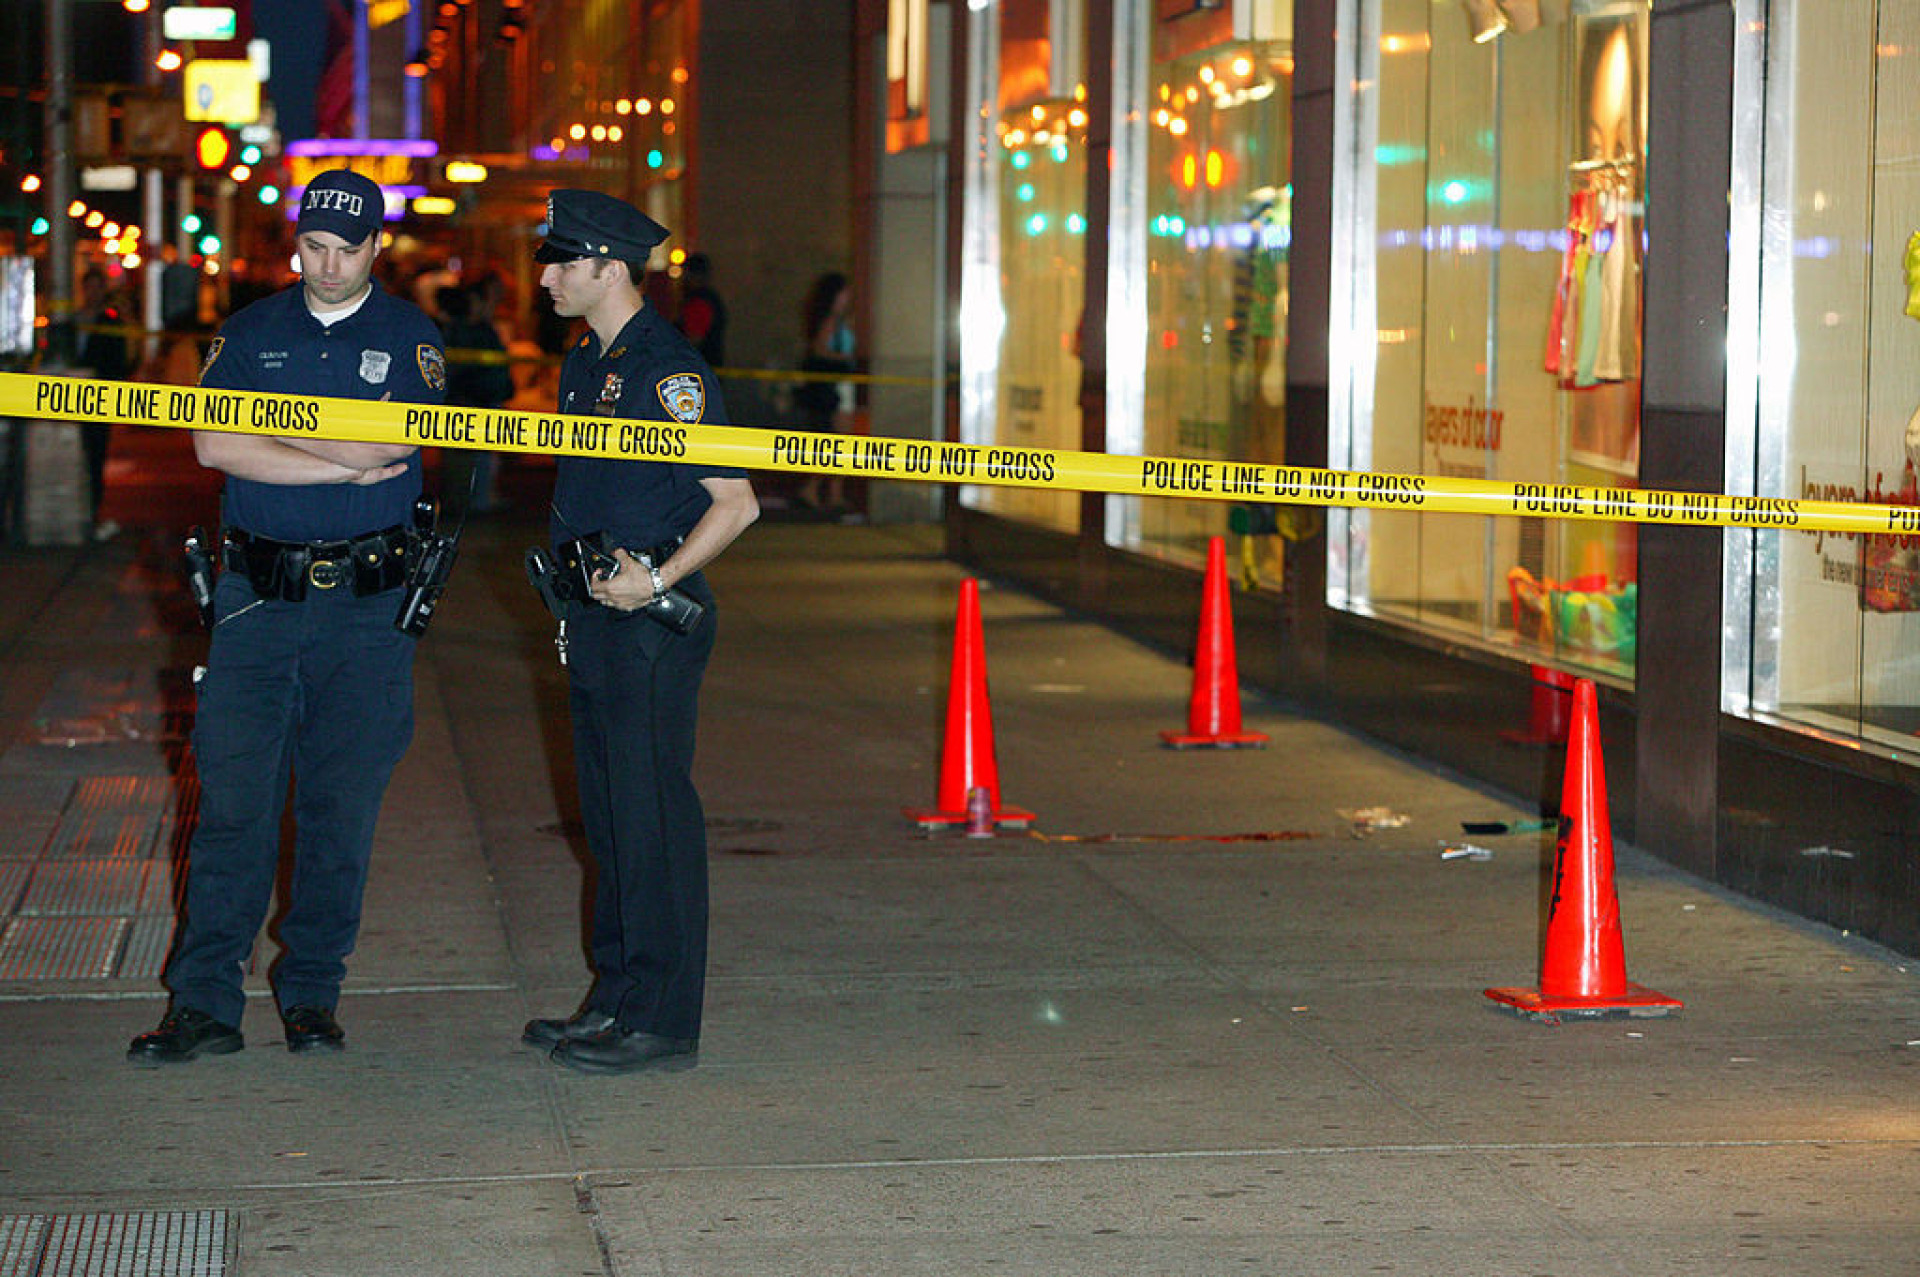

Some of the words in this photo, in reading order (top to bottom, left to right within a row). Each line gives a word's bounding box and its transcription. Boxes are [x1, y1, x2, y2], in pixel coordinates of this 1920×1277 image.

[306, 189, 363, 216] NYPD
[37, 382, 108, 416] POLICE
[116, 388, 160, 420] LINE
[169, 392, 195, 422] DO
[204, 395, 244, 425] NOT
[251, 398, 319, 431] CROSS
[406, 409, 476, 442] POLICE
[485, 415, 529, 445] LINE
[538, 420, 563, 448] DO
[572, 422, 612, 450] NOT
[619, 426, 686, 457] CROSS
[774, 435, 844, 467] POLICE
[853, 441, 896, 471] LINE
[906, 445, 932, 473] DO
[940, 448, 980, 476] NOT
[988, 450, 1054, 481] CROSS
[1142, 461, 1213, 491] POLICE
[1222, 466, 1264, 494] LINE
[1275, 469, 1301, 497] DO
[1310, 472, 1348, 499] NOT
[1358, 475, 1425, 504] CROSS
[1513, 485, 1582, 514] POLICE
[1594, 490, 1635, 516] LINE
[1648, 493, 1673, 518] DO
[1683, 495, 1717, 520] NOT
[1731, 499, 1798, 525] CROSS
